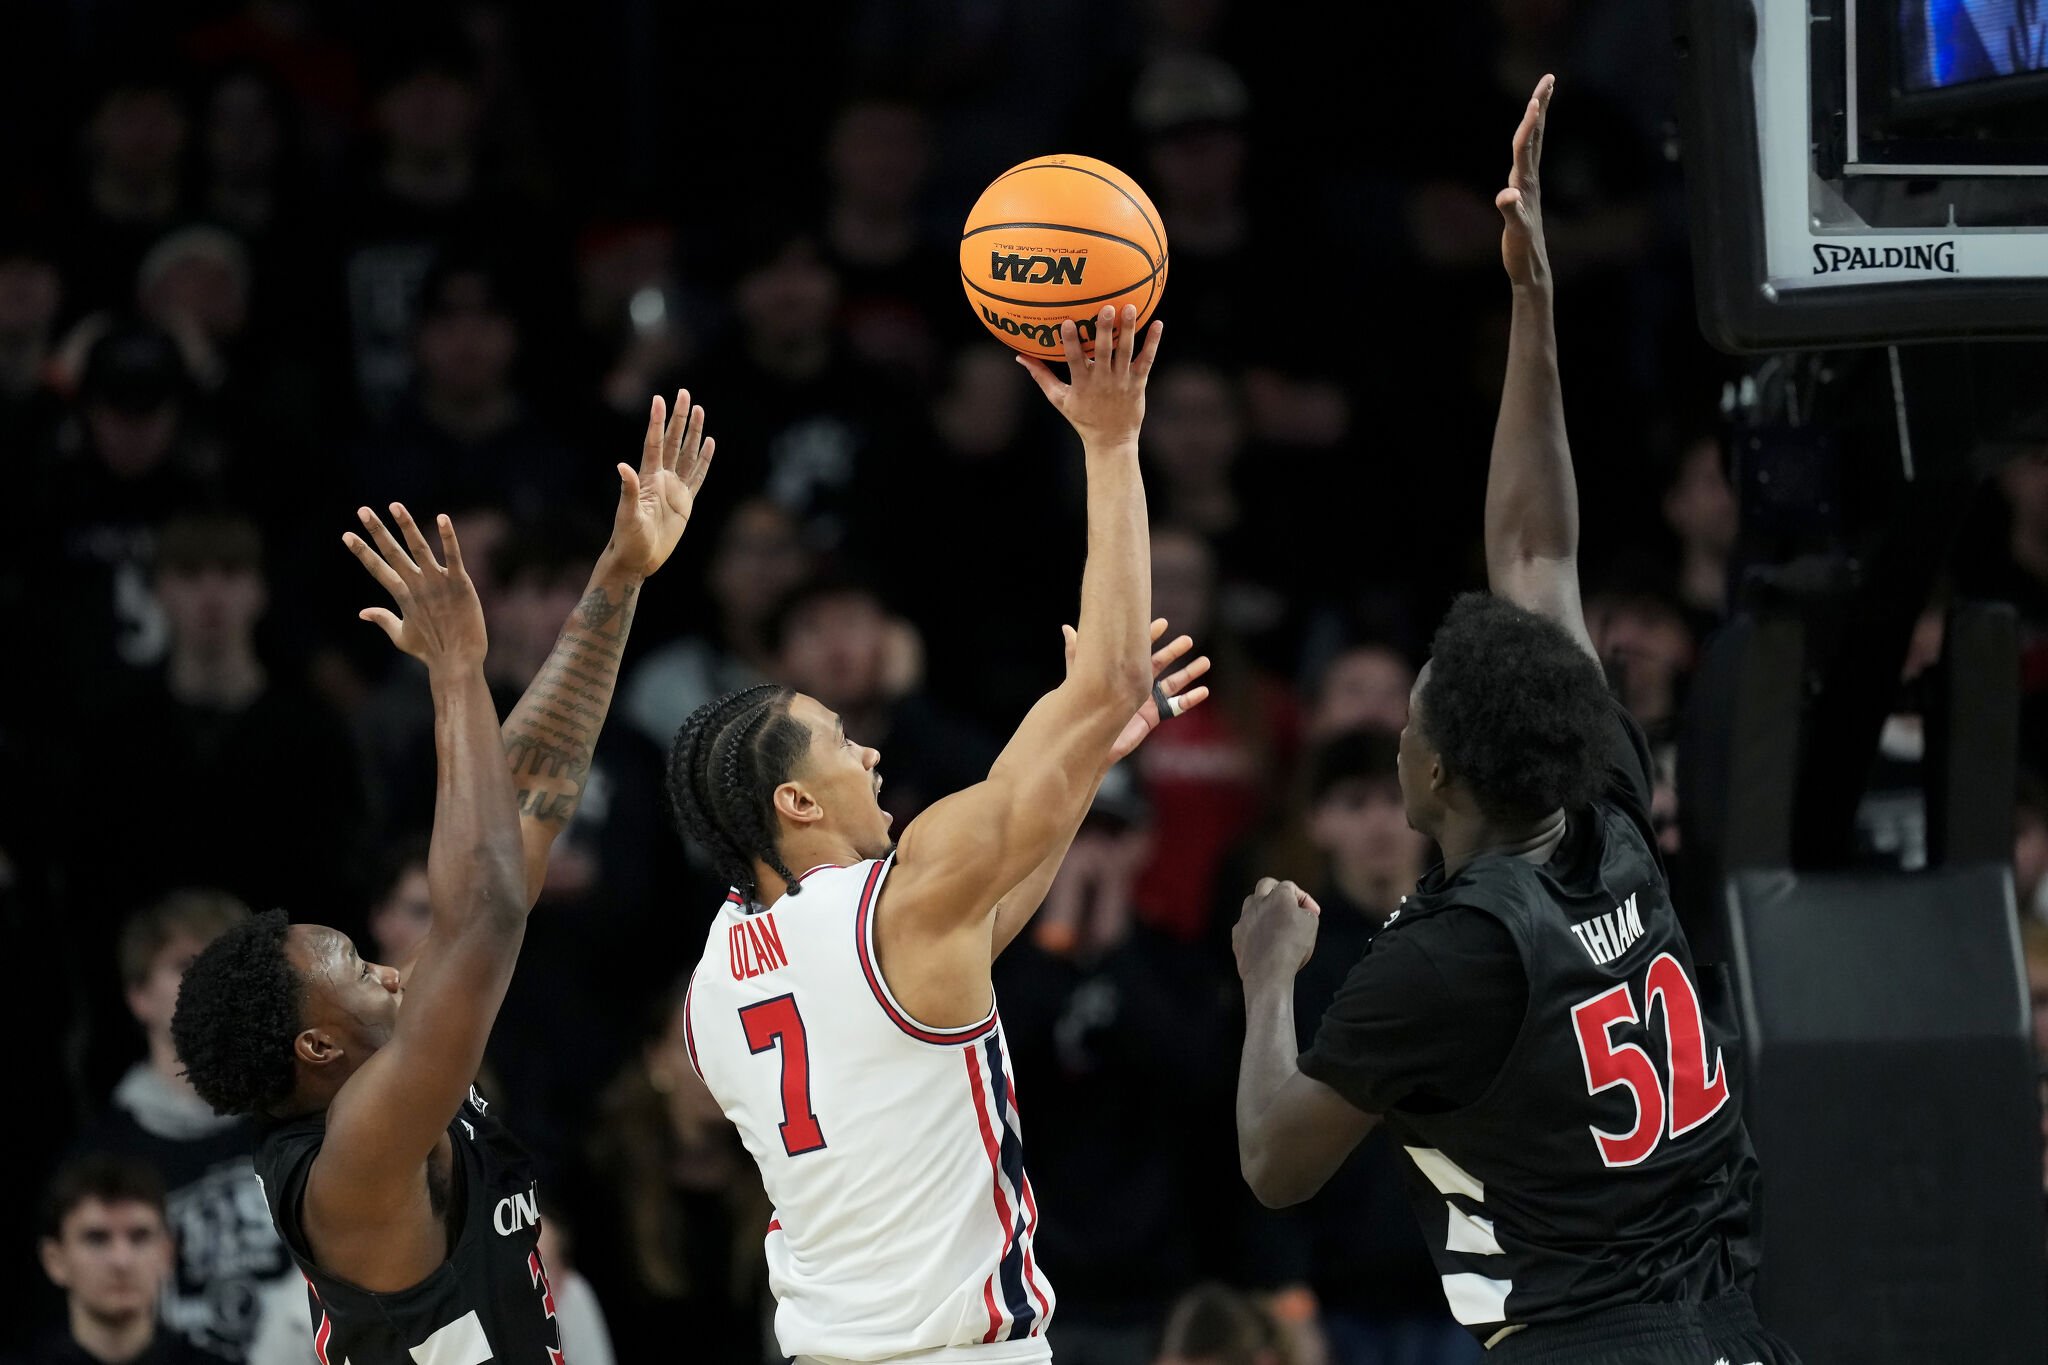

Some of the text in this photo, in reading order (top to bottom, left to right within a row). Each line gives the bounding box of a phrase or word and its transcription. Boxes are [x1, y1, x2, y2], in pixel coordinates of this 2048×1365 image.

[991, 251, 1087, 285] NCAA
[1813, 241, 1955, 275] SPALDING
[729, 912, 788, 981] UZAN
[1570, 892, 1645, 965] THIAM
[737, 992, 828, 1158] 7
[1570, 952, 1730, 1167] 52
[493, 1180, 541, 1236] CIN
